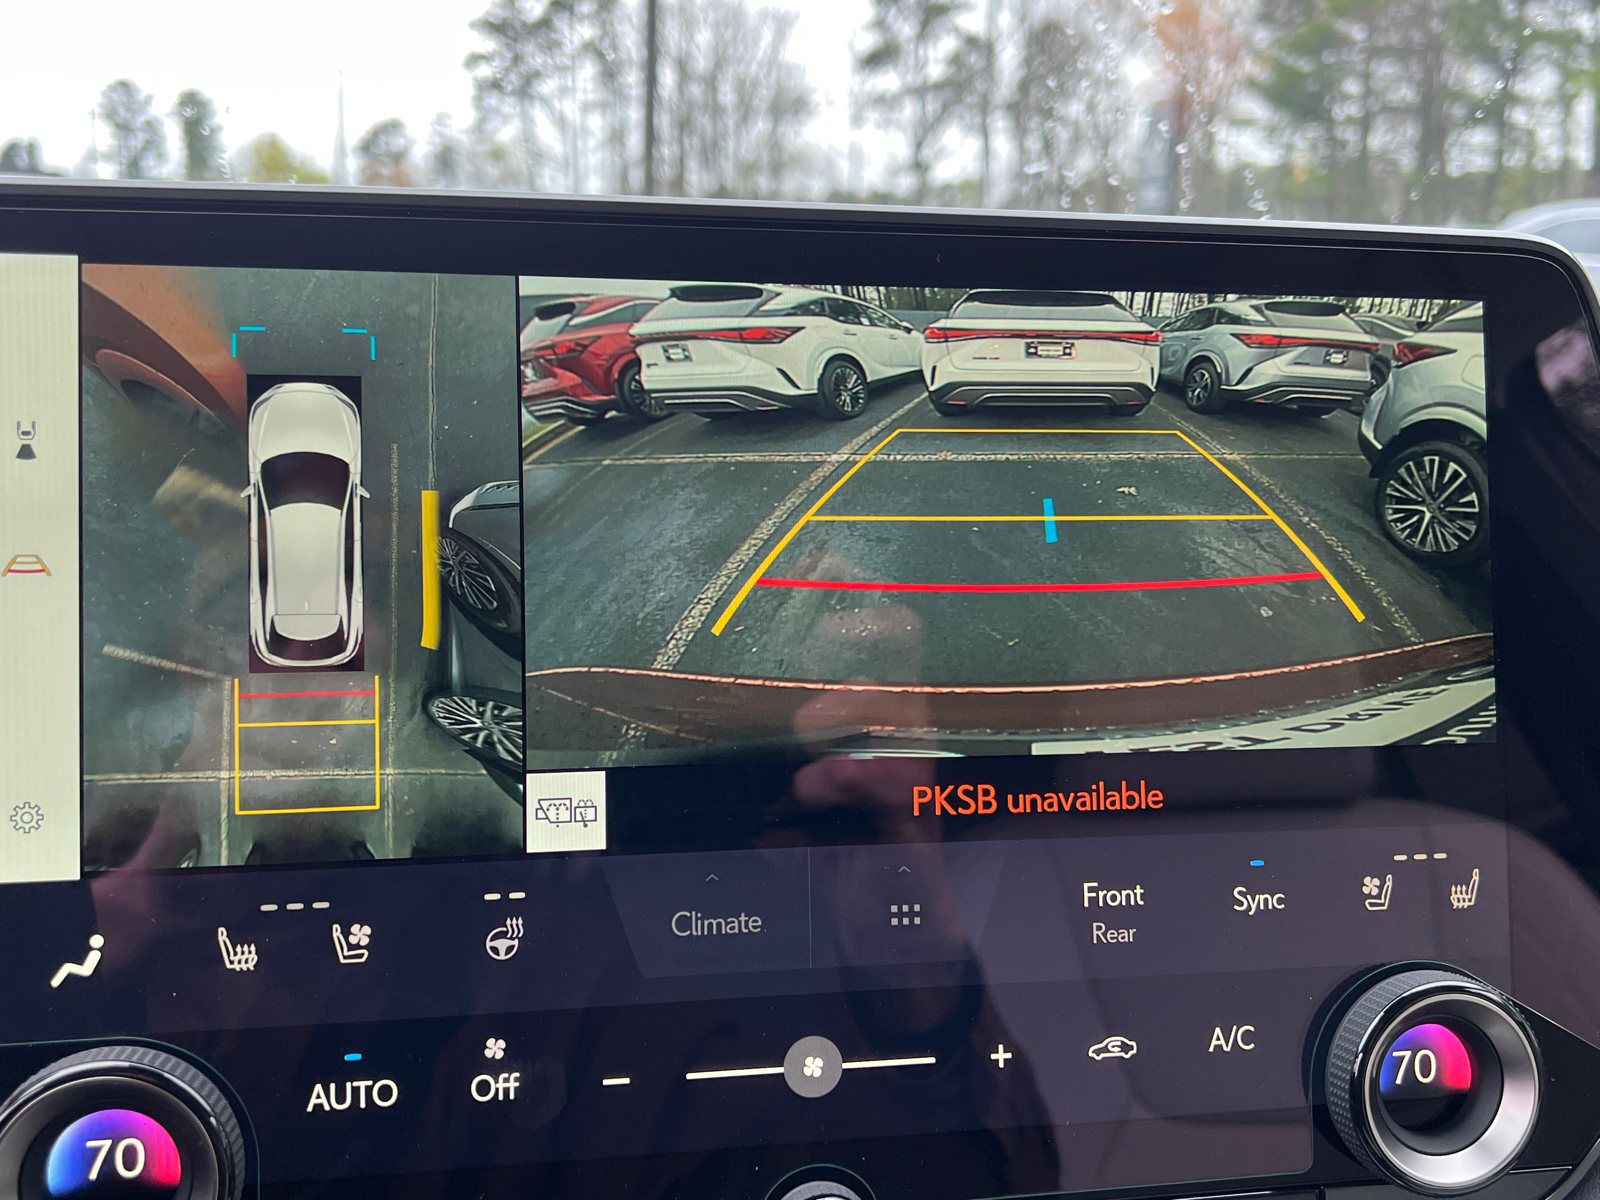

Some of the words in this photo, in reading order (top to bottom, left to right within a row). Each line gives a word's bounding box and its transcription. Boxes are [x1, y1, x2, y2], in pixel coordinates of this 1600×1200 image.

[912, 784, 998, 817] PKSB
[1007, 780, 1164, 813] unavailable
[1082, 881, 1146, 908] Front
[1233, 886, 1286, 915] Sync
[671, 908, 763, 937] Climate
[1091, 922, 1137, 944] Rear
[1208, 1025, 1255, 1053] A/C
[1392, 1049, 1438, 1085] 70
[306, 1079, 399, 1113] AUTO
[470, 1072, 521, 1102] Off
[85, 1137, 146, 1181] 70
